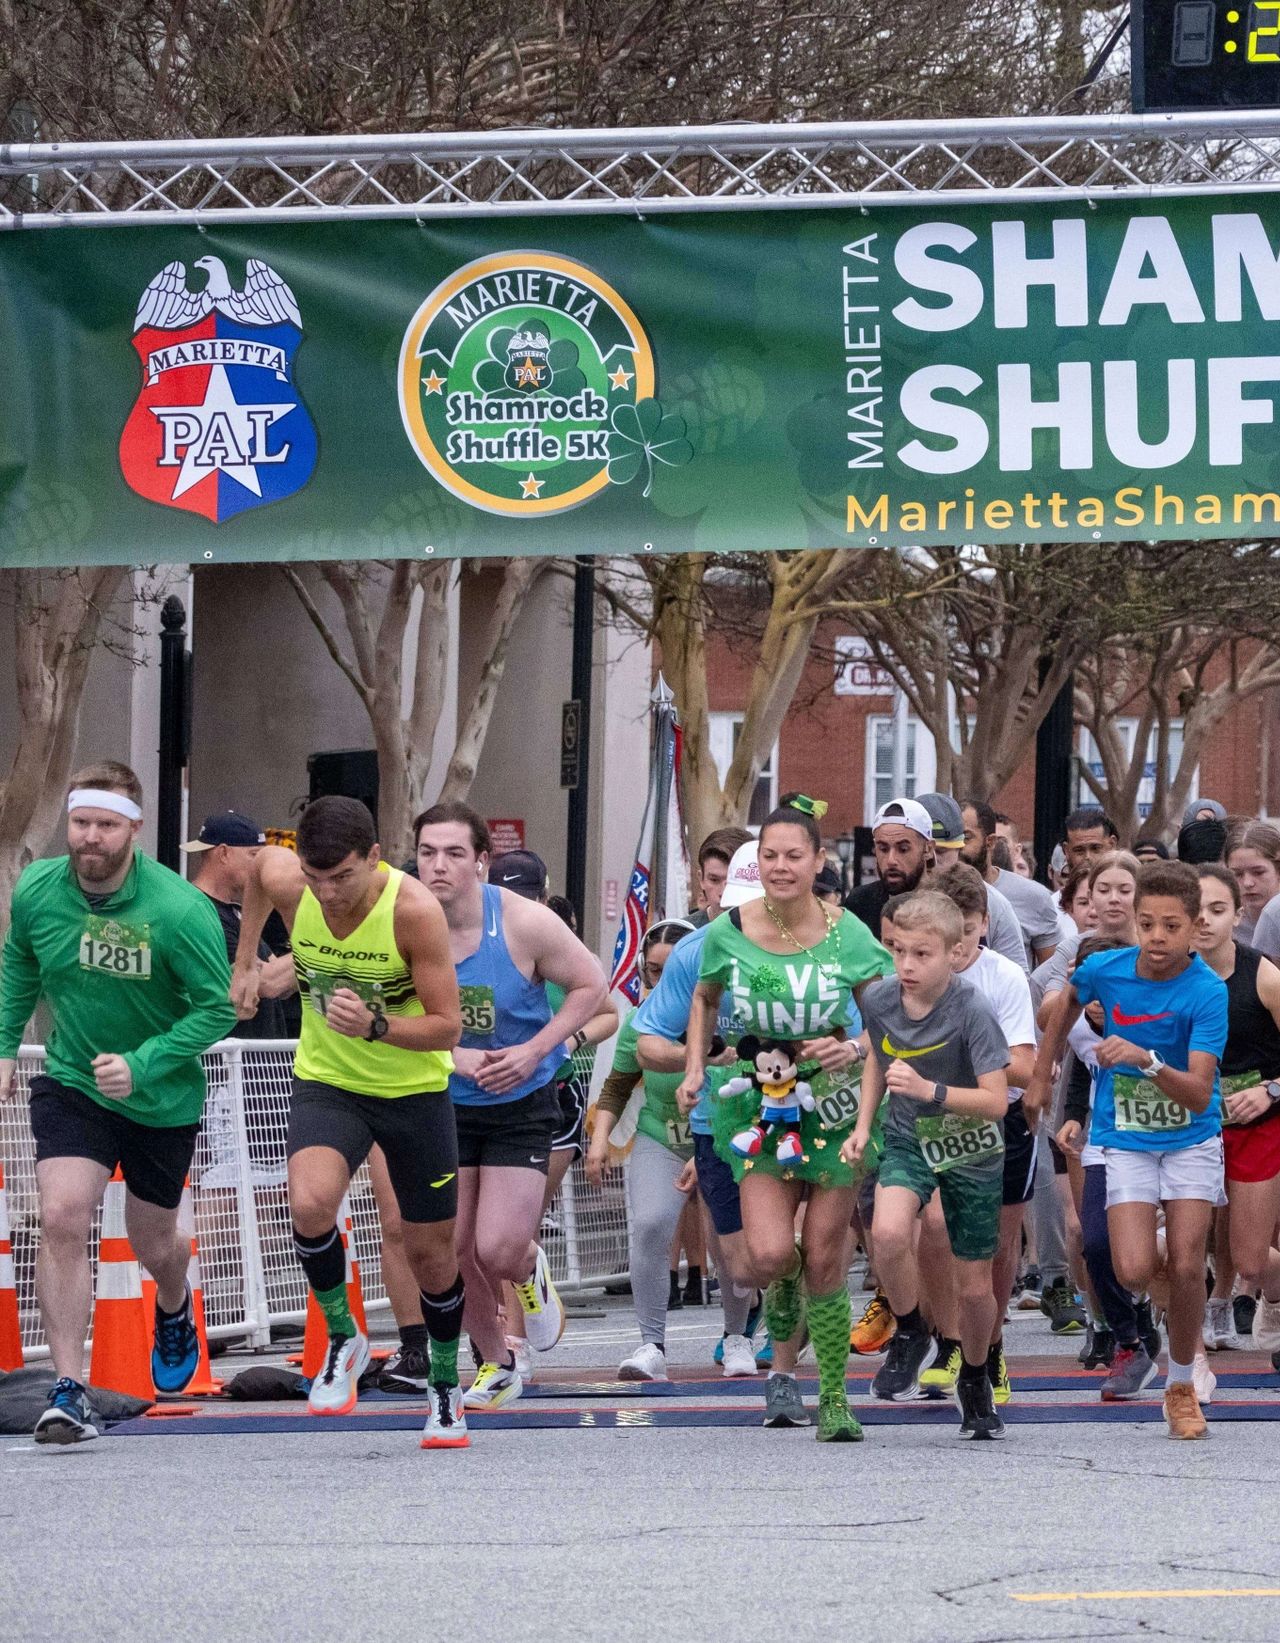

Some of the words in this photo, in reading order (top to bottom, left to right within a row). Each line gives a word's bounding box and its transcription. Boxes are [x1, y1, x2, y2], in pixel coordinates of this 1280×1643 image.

[444, 273, 598, 330] MARIETTA
[151, 341, 284, 373] MARIETTA
[843, 232, 883, 469] MARIETTA
[514, 367, 546, 382] PAL
[447, 389, 607, 425] Shamrock
[157, 411, 290, 467] PAL
[447, 428, 561, 463] Shuffle
[566, 430, 610, 460] 5K
[84, 940, 143, 973] 1281
[319, 946, 390, 962] BROOKS
[461, 1005, 493, 1029] 35
[734, 997, 840, 1036] PINK
[820, 1087, 860, 1124] 09
[1119, 1099, 1187, 1126] 1549
[925, 1124, 997, 1164] 0885
